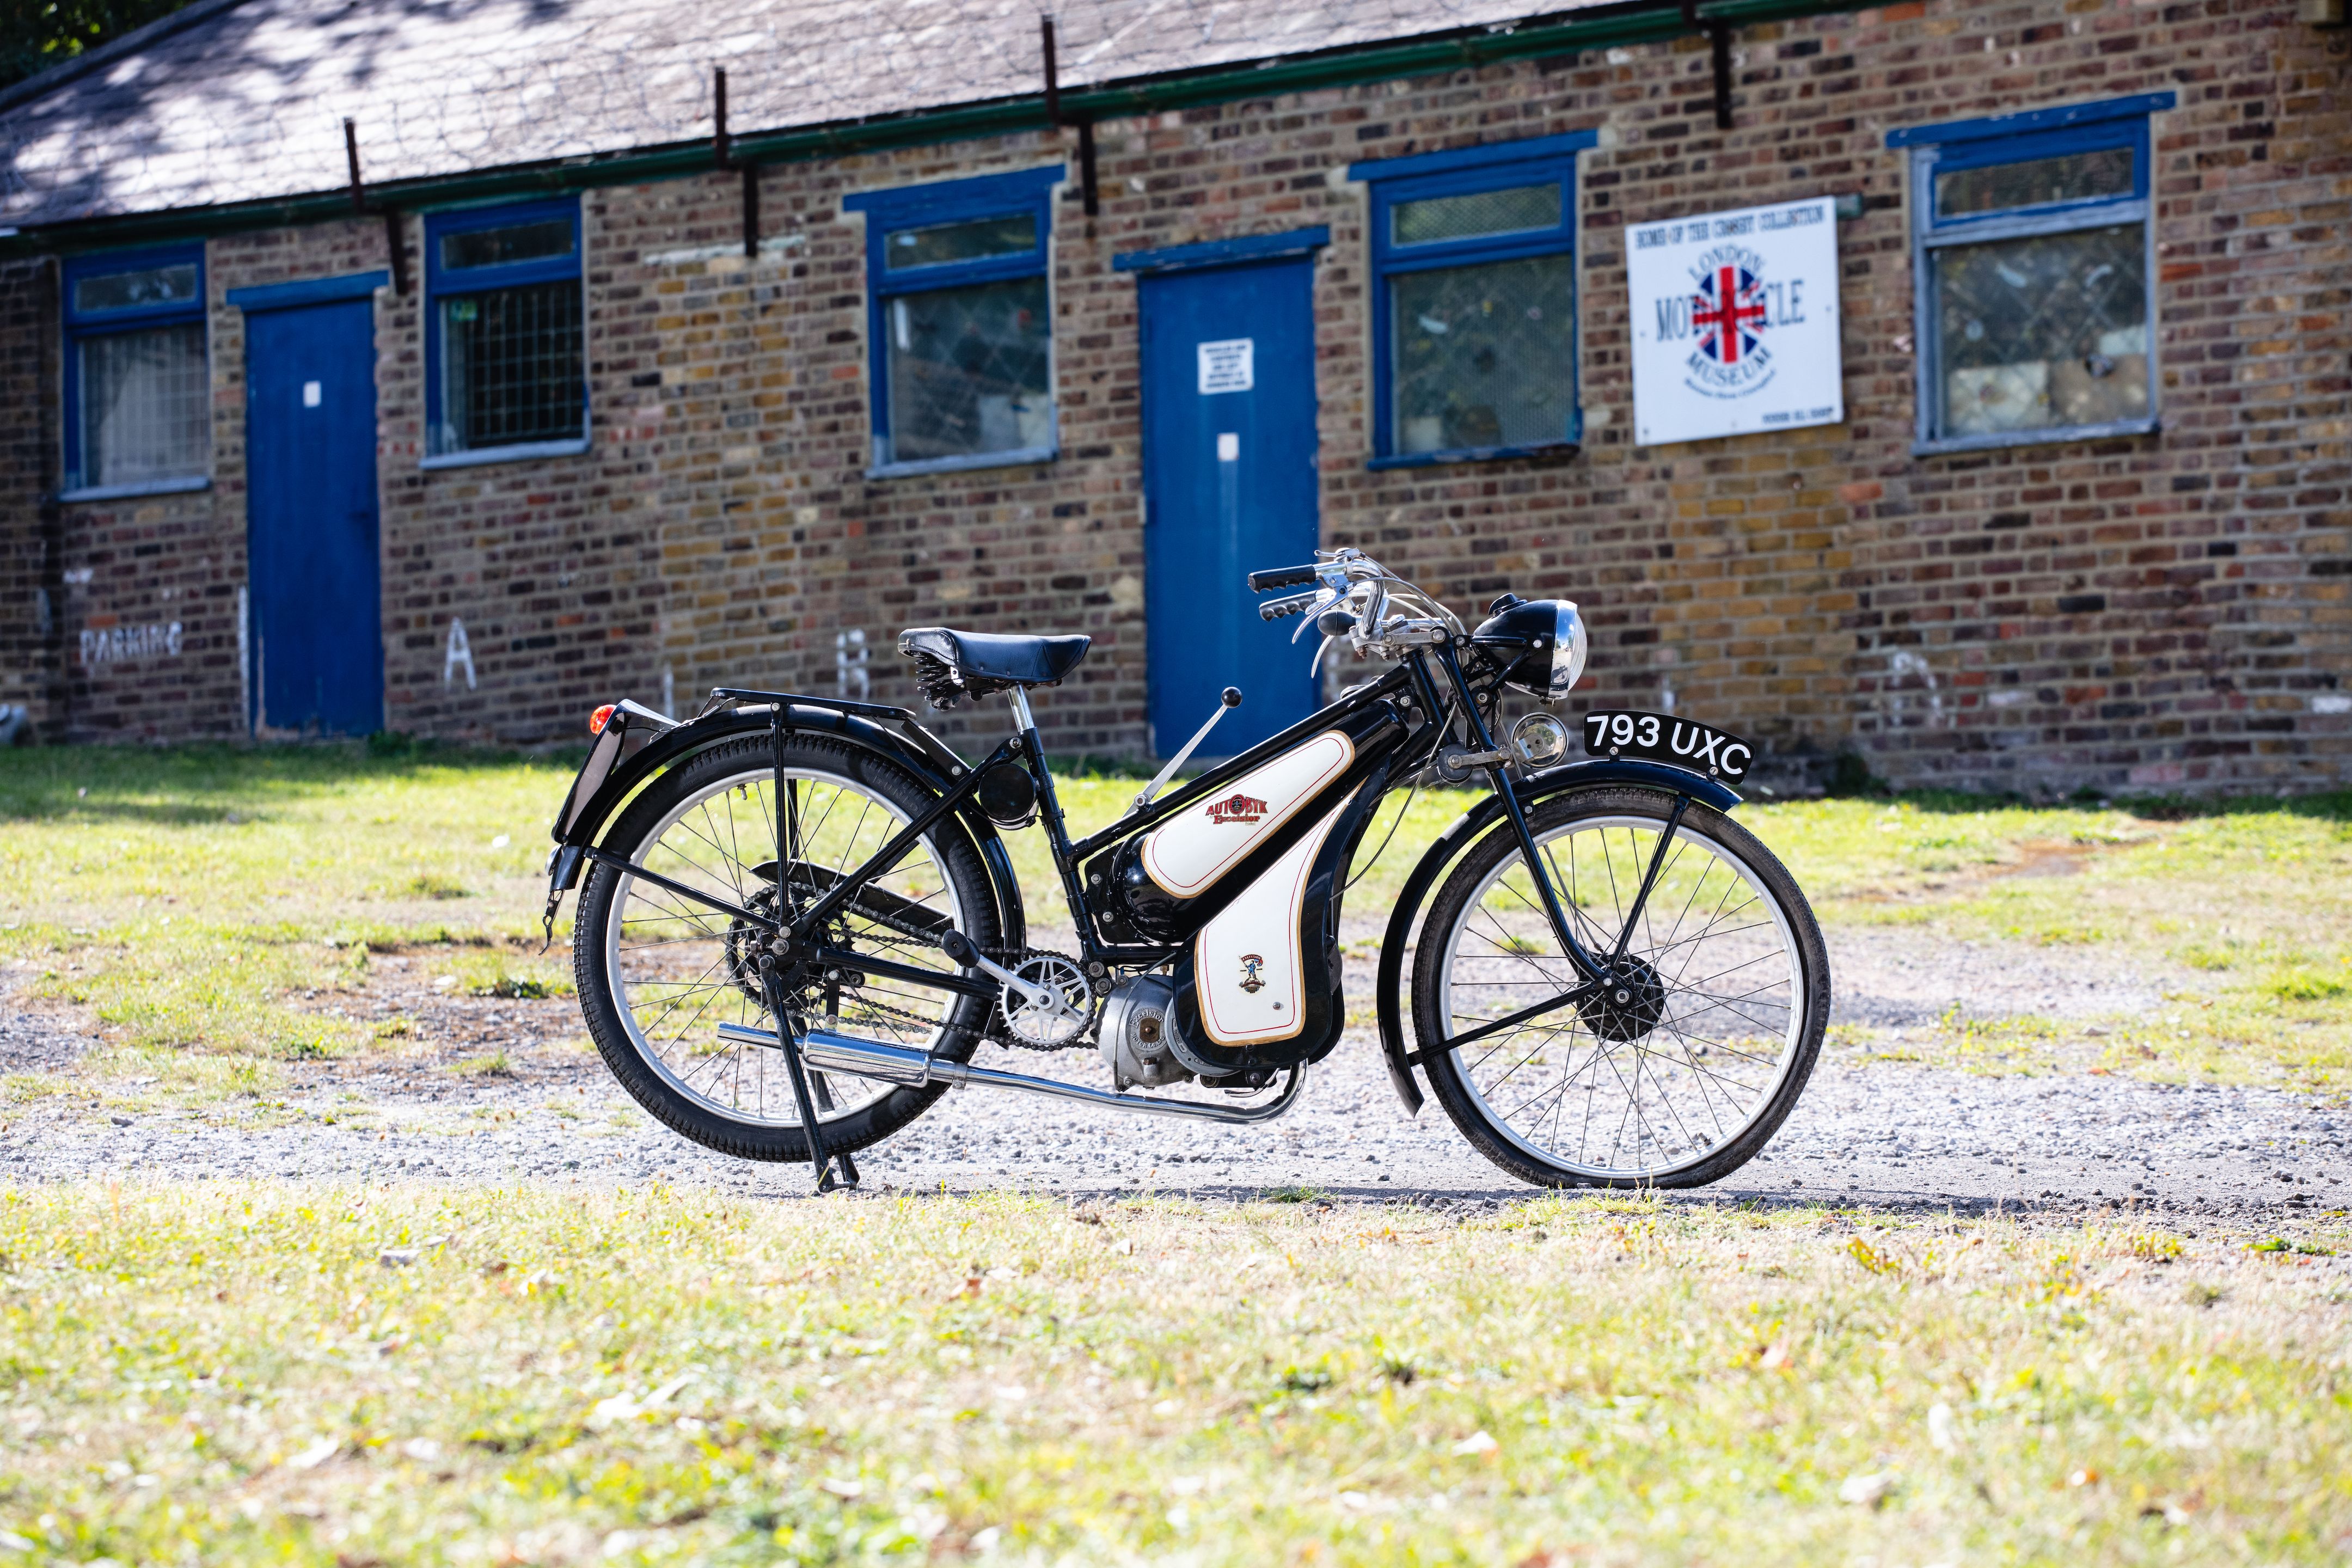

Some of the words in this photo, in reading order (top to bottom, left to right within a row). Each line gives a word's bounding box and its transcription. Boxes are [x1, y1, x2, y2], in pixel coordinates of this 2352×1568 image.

[1688, 243, 1766, 281] LONDON
[1686, 346, 1772, 386] MUSEUM
[79, 621, 183, 666] PARKING
[444, 617, 476, 690] A
[1587, 714, 1661, 747] 793
[1670, 722, 1751, 775] UXC
[1205, 794, 1268, 816] AUTOBYK
[1213, 813, 1260, 824] Excelsior
[948, 848, 979, 920] UTOCYCLE
[1129, 1009, 1165, 1028] Excelsior
[1130, 1033, 1147, 1048] MOTOR
